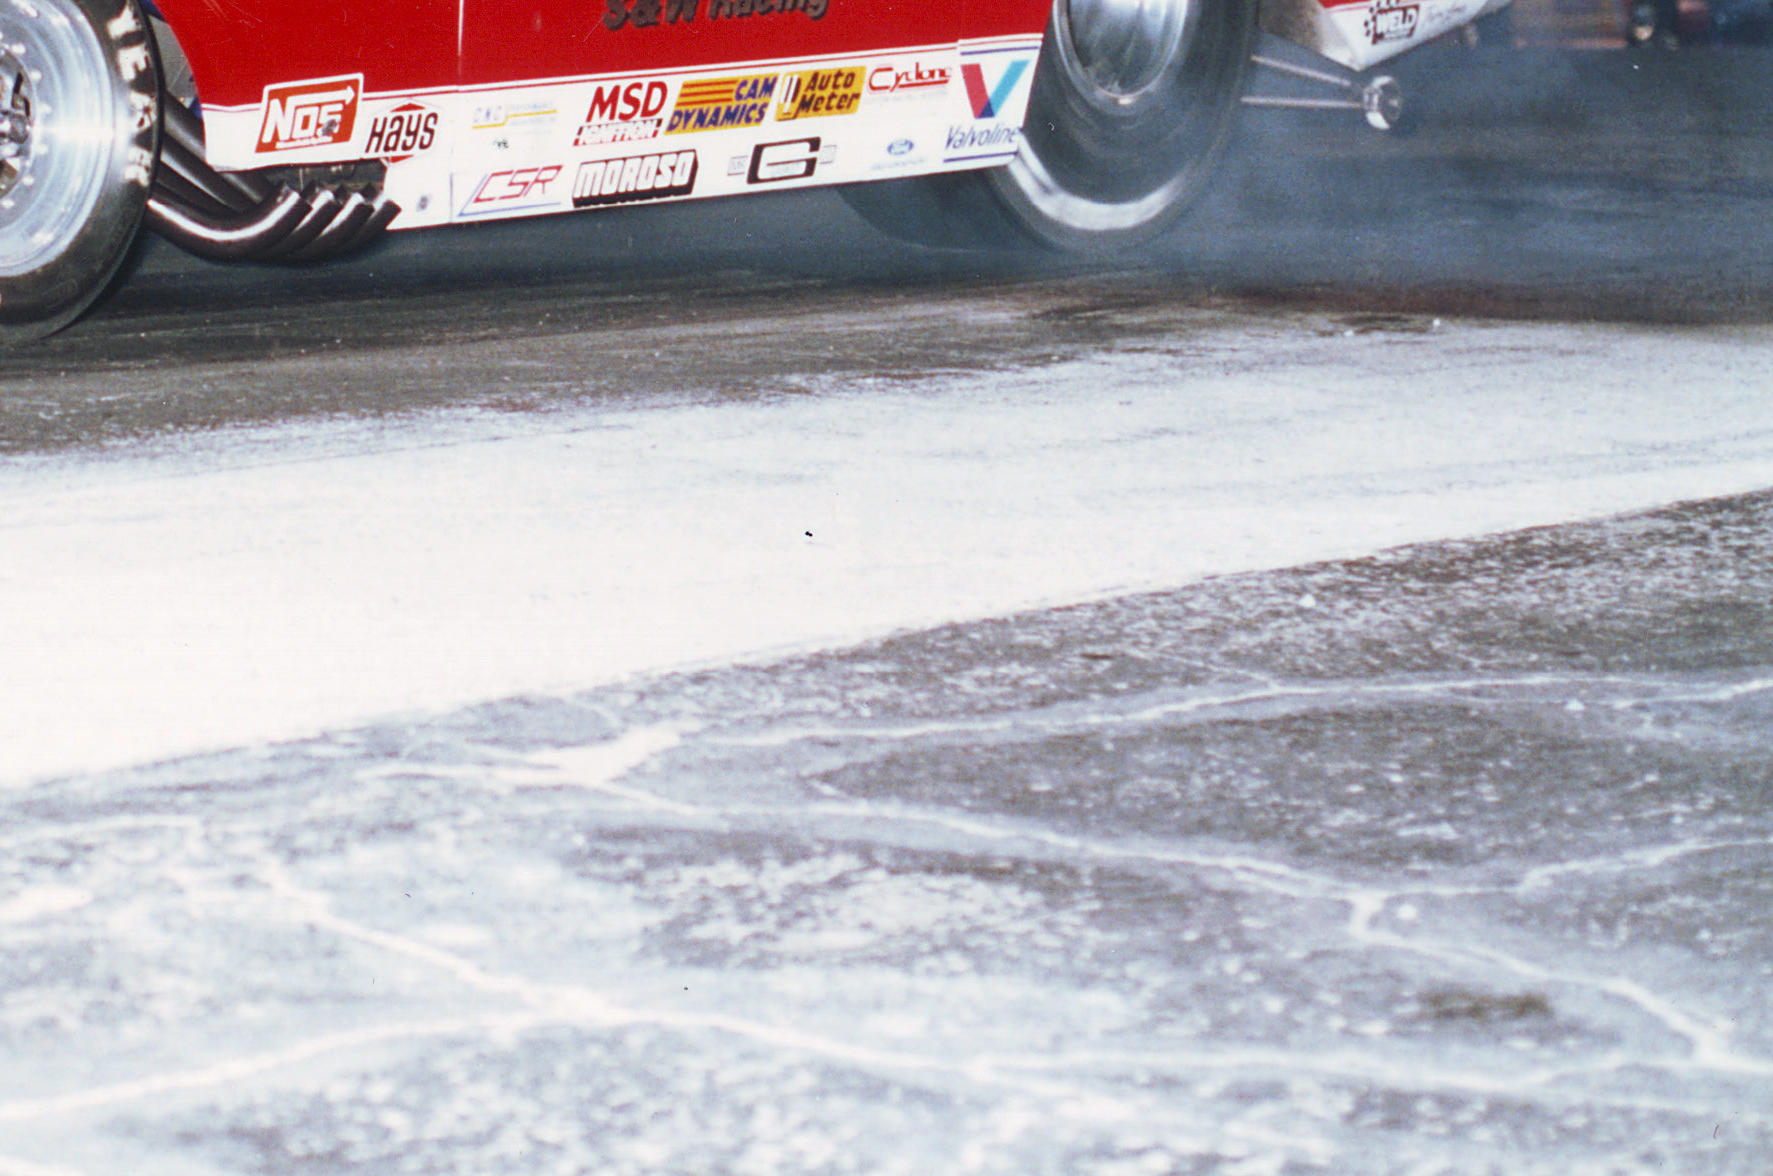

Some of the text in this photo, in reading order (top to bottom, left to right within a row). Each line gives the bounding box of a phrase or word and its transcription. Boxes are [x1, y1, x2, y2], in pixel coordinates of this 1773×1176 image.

[734, 76, 777, 101] CAM
[805, 70, 856, 92] Auto
[262, 88, 346, 143] NOS
[586, 81, 668, 122] MSD
[666, 102, 769, 132] DYNAMICS
[796, 91, 861, 114] Meter
[365, 112, 439, 154] Hays
[945, 124, 1021, 150] Valvoline
[473, 165, 563, 203] CSR
[573, 150, 697, 203] MOROSO
